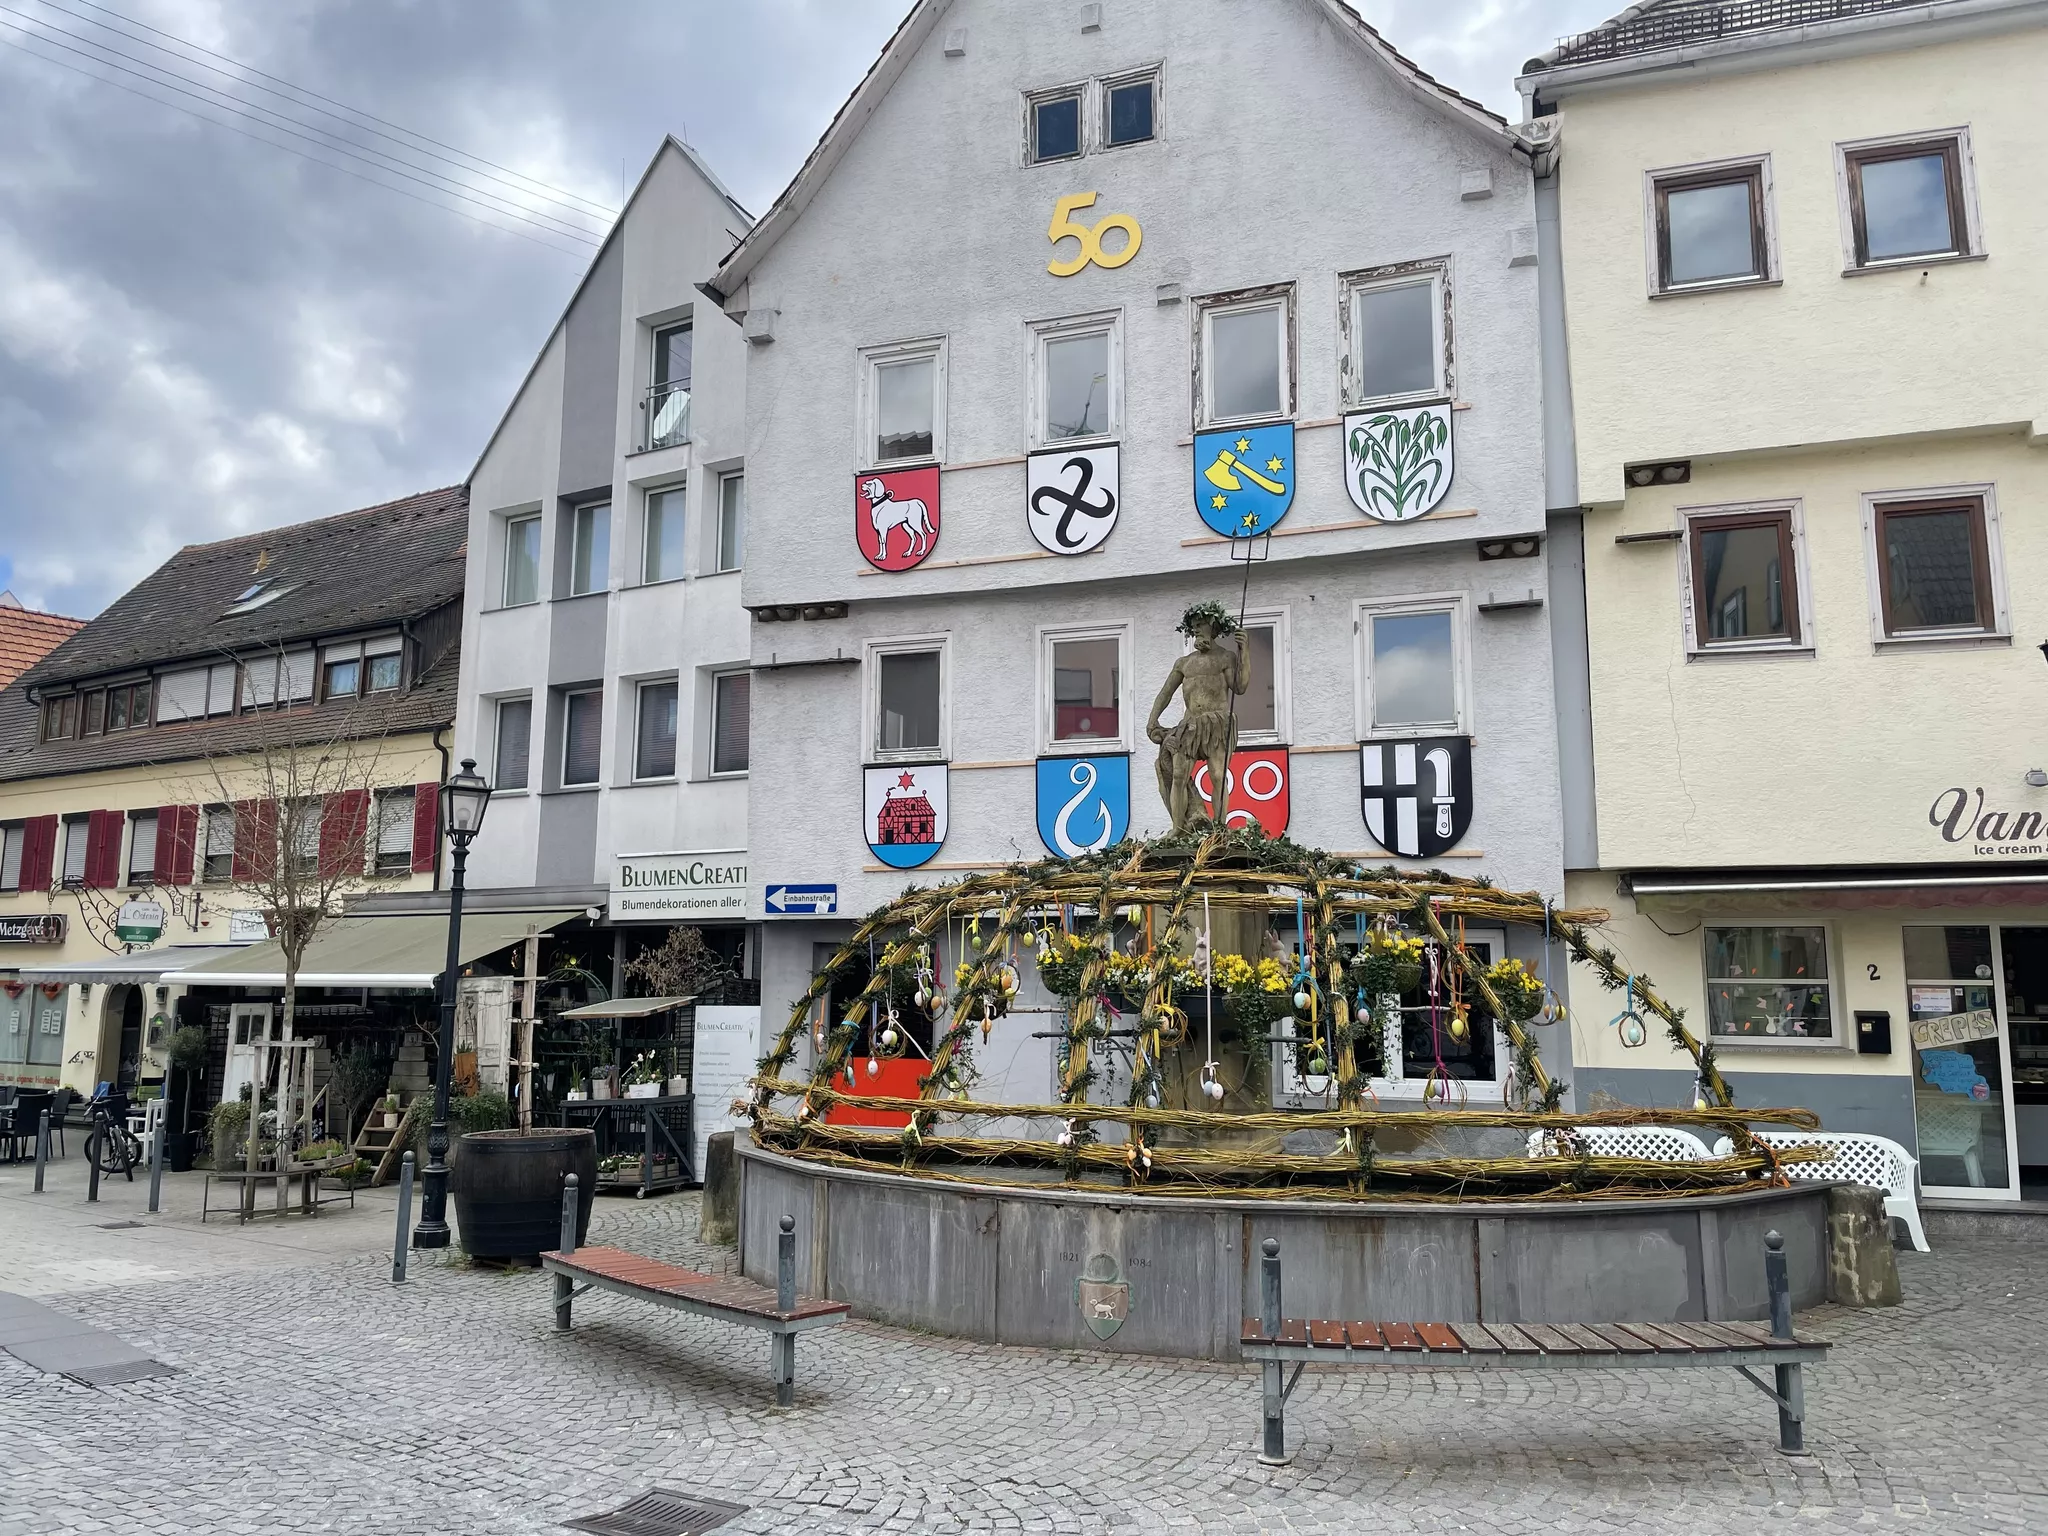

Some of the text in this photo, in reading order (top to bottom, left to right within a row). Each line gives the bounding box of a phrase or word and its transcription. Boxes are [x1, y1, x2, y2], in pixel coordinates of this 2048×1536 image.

[1047, 191, 1142, 277] 50
[1929, 787, 2048, 842] Van
[1974, 845, 2042, 855] Ice cream
[622, 896, 741, 910] Blumendekorationen aller
[784, 894, 831, 902] Einbahnstraße
[1867, 964, 1881, 981] 2
[1060, 1252, 1079, 1262] 1821
[1128, 1258, 1152, 1268] 1984
